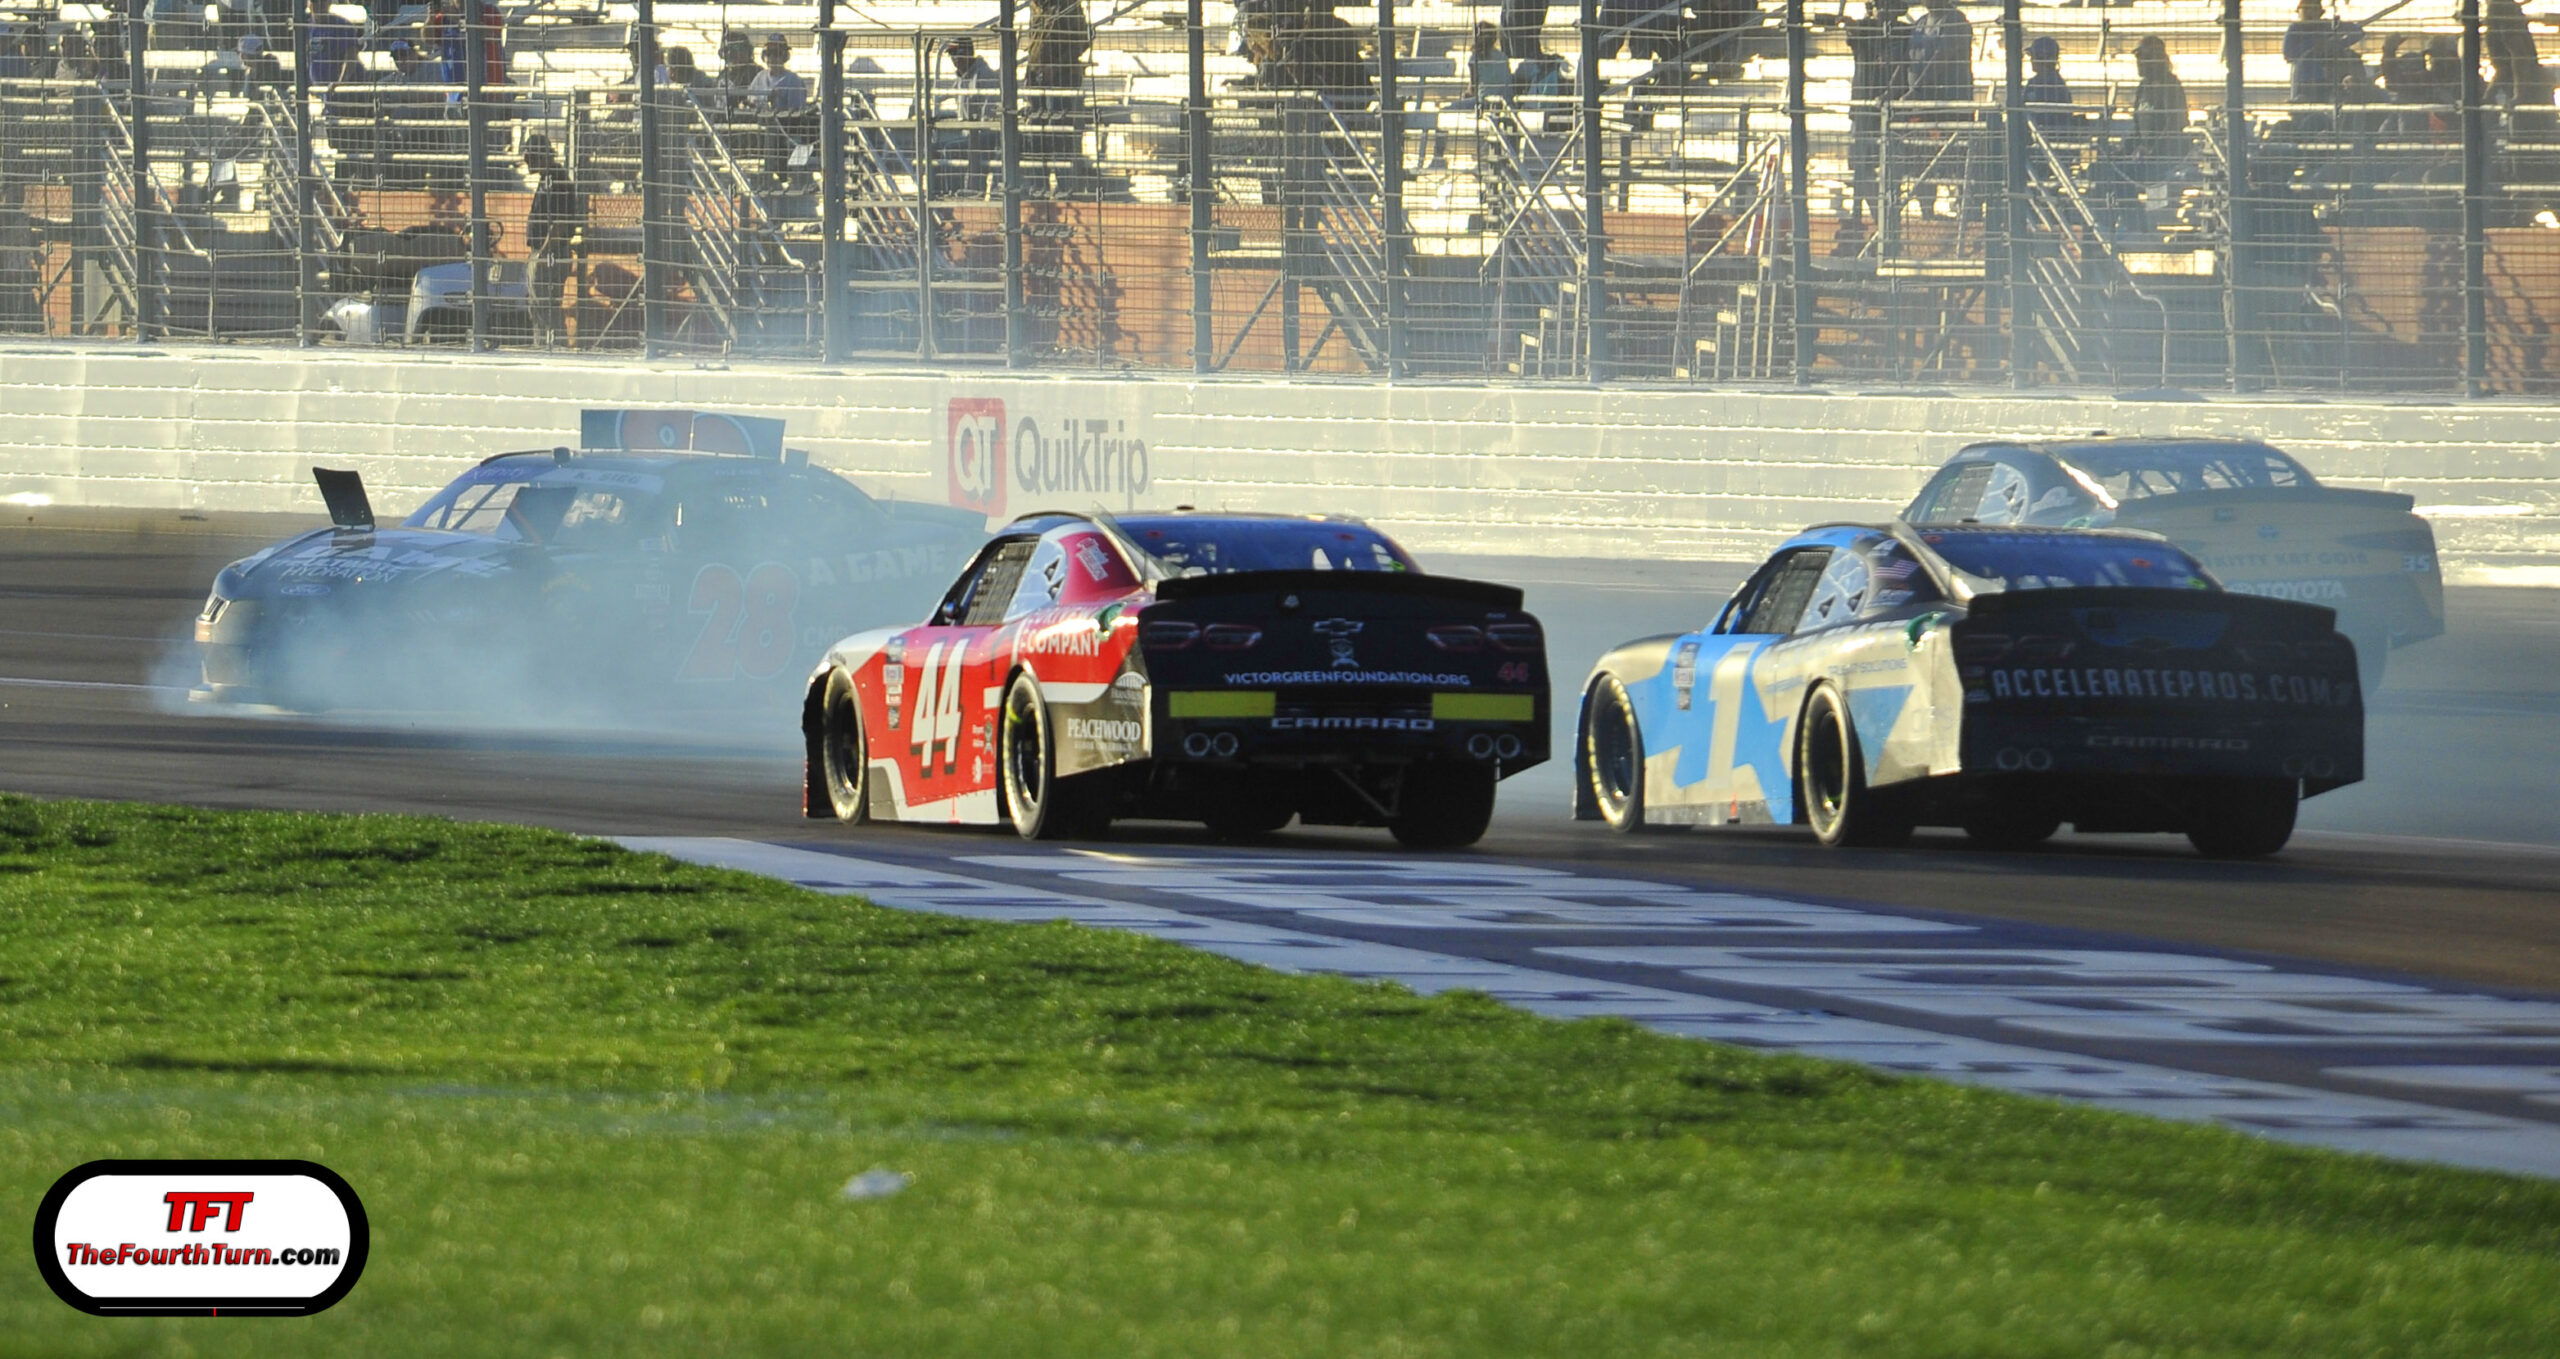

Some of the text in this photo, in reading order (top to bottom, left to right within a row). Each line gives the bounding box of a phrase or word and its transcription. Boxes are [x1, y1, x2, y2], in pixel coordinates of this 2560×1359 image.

[954, 413, 1148, 511] QT QuikTrip
[808, 543, 948, 587] A GAME
[2257, 579, 2348, 599] TOYOTA
[673, 560, 801, 683] 28
[1027, 628, 1100, 657] COMPANY
[1224, 670, 1471, 686] VICTORGREENFOUNDATION.ORG
[1497, 662, 1529, 683] 44
[1992, 668, 2332, 704] ACCELERATEPROS.COM
[911, 638, 971, 772] 44
[1706, 641, 1762, 789] 1
[1067, 718, 1142, 741] PEACHWOOD
[1271, 717, 1435, 731] CAMARO
[2086, 734, 2249, 751] CAMARO
